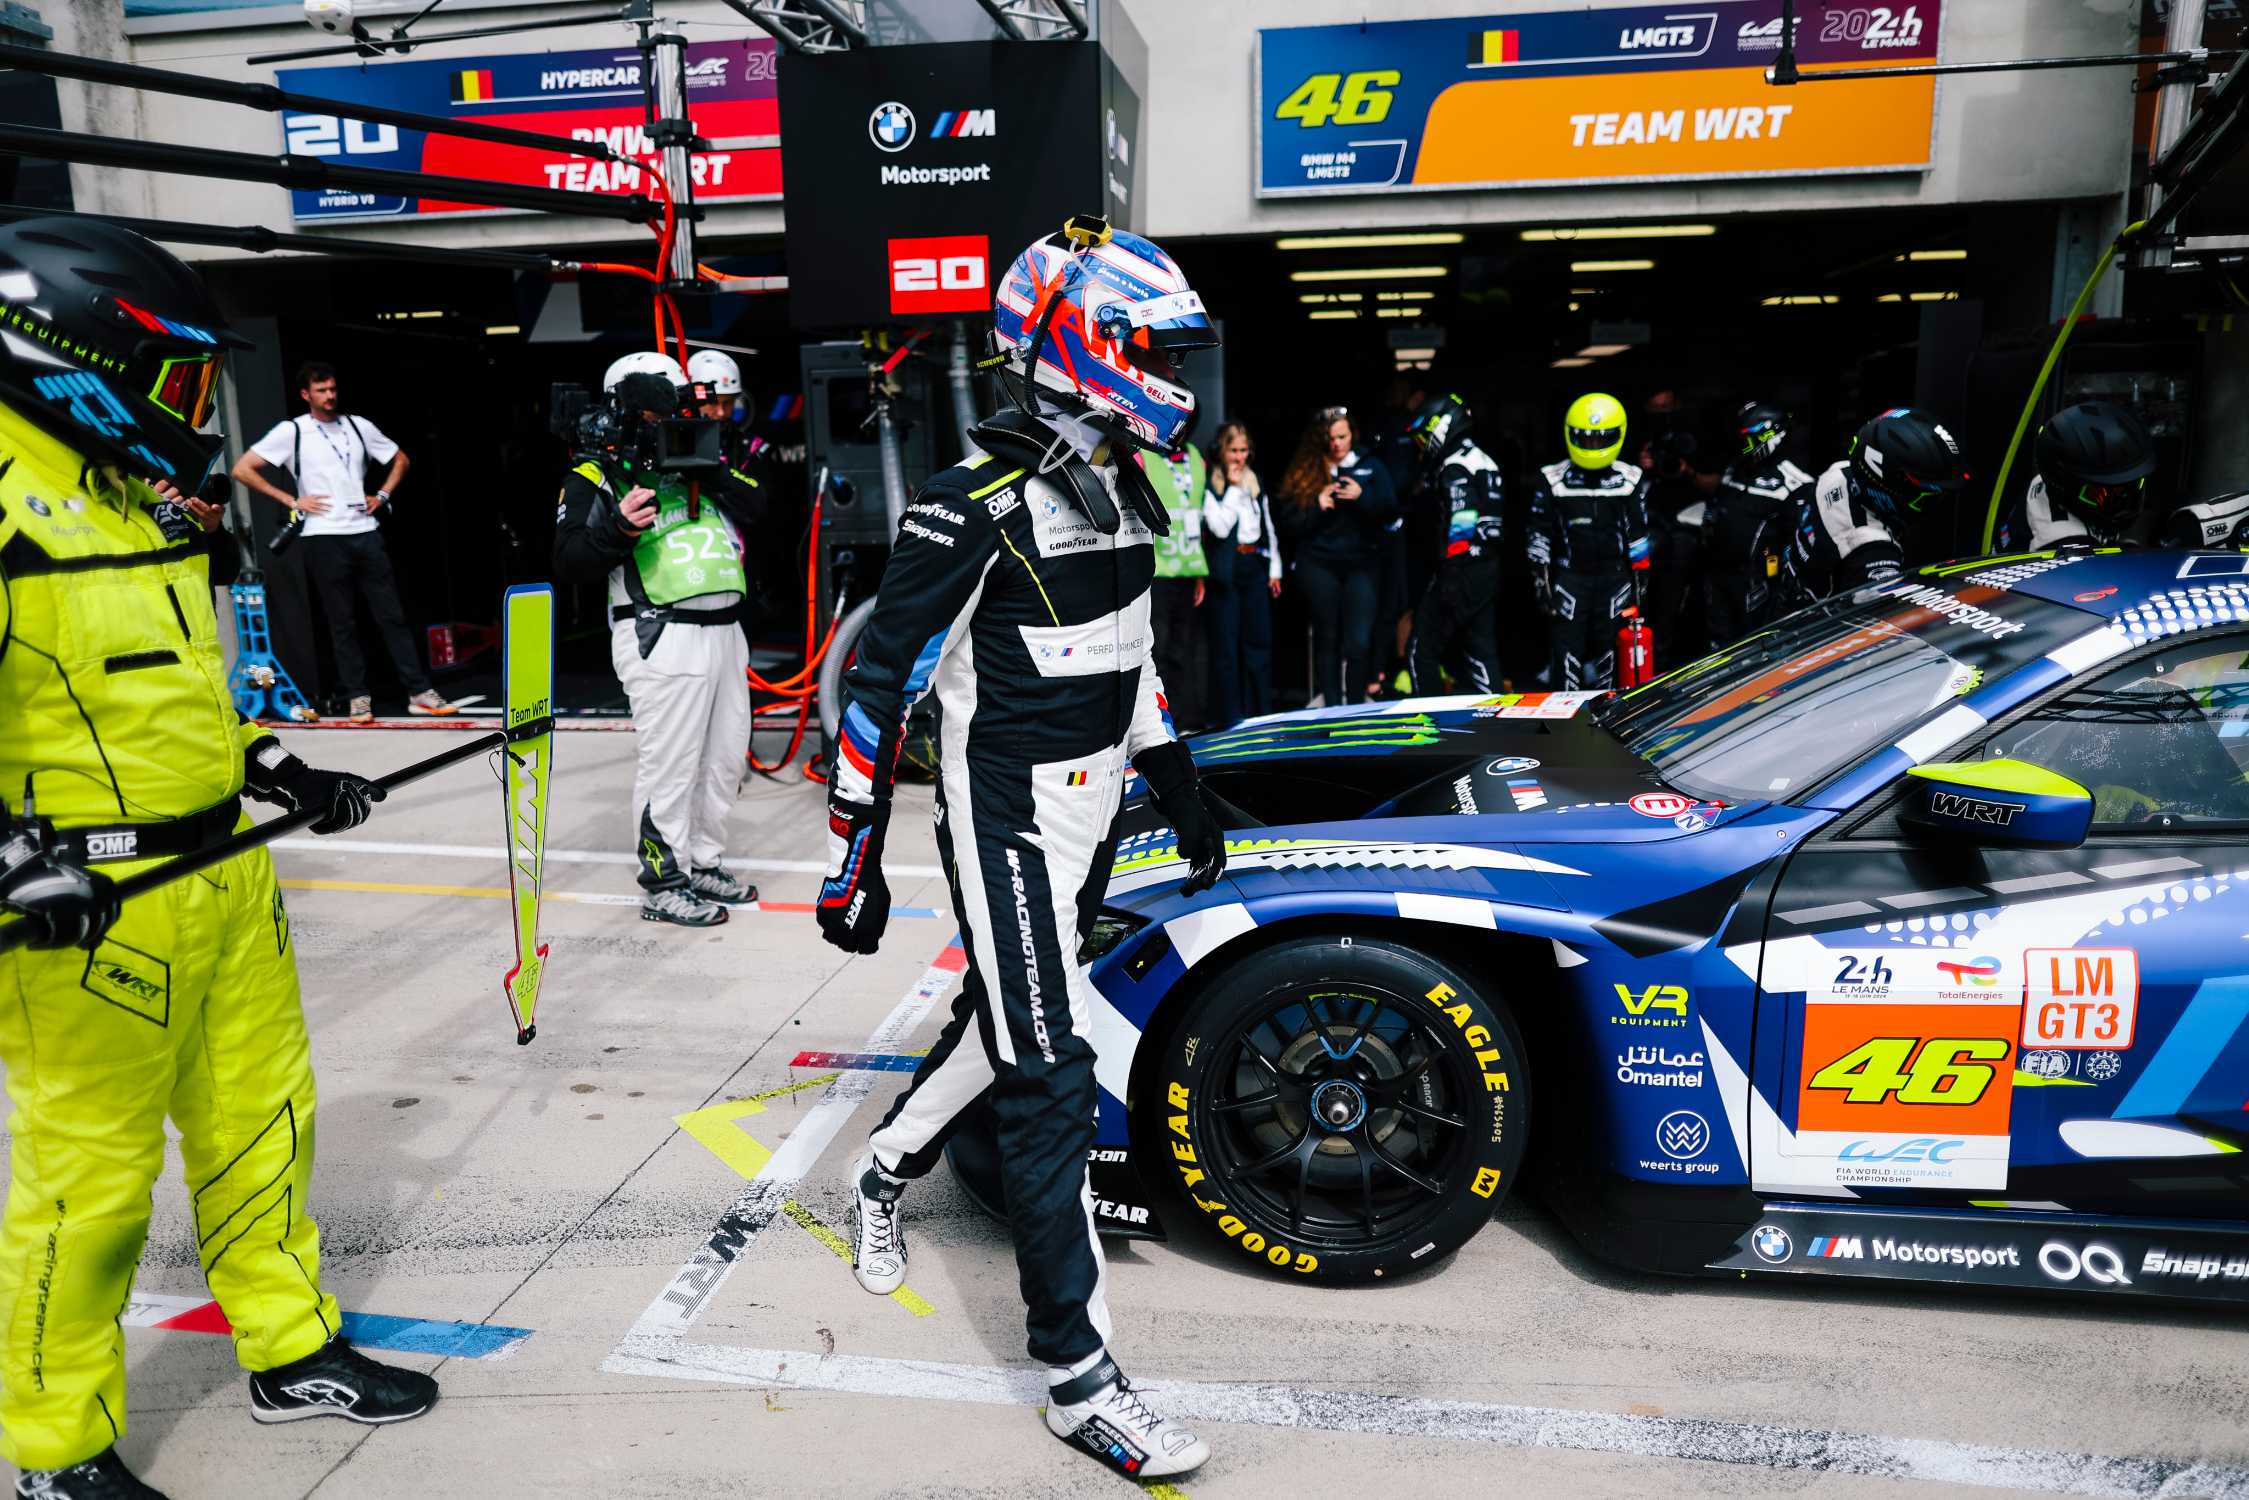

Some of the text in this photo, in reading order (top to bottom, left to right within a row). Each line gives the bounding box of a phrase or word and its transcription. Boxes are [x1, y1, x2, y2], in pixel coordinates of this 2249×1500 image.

[1619, 26, 1696, 49] LMGT3
[1862, 38, 1918, 49] LE MANS
[541, 66, 641, 90] HYPERCAR
[1275, 70, 1401, 127] 46
[286, 114, 399, 157] 20
[1570, 105, 1793, 146] TEAM WRT
[544, 162, 640, 192] TEAM
[881, 164, 990, 185] Motorsport
[319, 194, 376, 207] HYBRID V8
[894, 256, 985, 291] 20
[11, 311, 127, 374] EQUIPMENT
[1146, 385, 1167, 402] BELL
[988, 490, 1017, 516] OMP
[1049, 538, 1098, 551] GOODYEAR
[1901, 587, 2026, 640] Motorsport
[510, 698, 549, 724] Team WRT
[1931, 792, 2026, 826] WRT
[87, 836, 138, 855] OMP
[844, 889, 867, 930] WRT
[1005, 848, 1056, 1064] W-RACINGTEAM.COM
[1834, 955, 1893, 985] 24h
[106, 967, 166, 998] WRT
[1832, 985, 1890, 994] LE MANS
[2050, 957, 2114, 997] LM
[1614, 984, 1689, 1016] VR
[1938, 991, 2004, 1001] TotalEnergies
[1611, 1016, 1687, 1028] EQUIPMENT
[2038, 1002, 2120, 1040] GT3
[1425, 982, 1510, 1093] EAGLE
[1618, 1046, 1704, 1067] عمانتل
[1808, 1037, 2011, 1106] 46
[2024, 1055, 2066, 1074] FIA
[1617, 1066, 1703, 1088] Omantel
[1838, 1138, 1965, 1165] WEC
[1640, 1160, 1720, 1175] weerts group
[1836, 1168, 1953, 1177] FIA WORLD ENDURANCE
[1836, 1175, 1912, 1184] CHAMPIONSHIP
[1090, 1191, 1150, 1224] YEAR
[1872, 1239, 2020, 1270] Motorsport
[2038, 1242, 2133, 1285] OQ
[2141, 1251, 2249, 1282] Snap-o
[1094, 1419, 1145, 1462] SKECHERS
